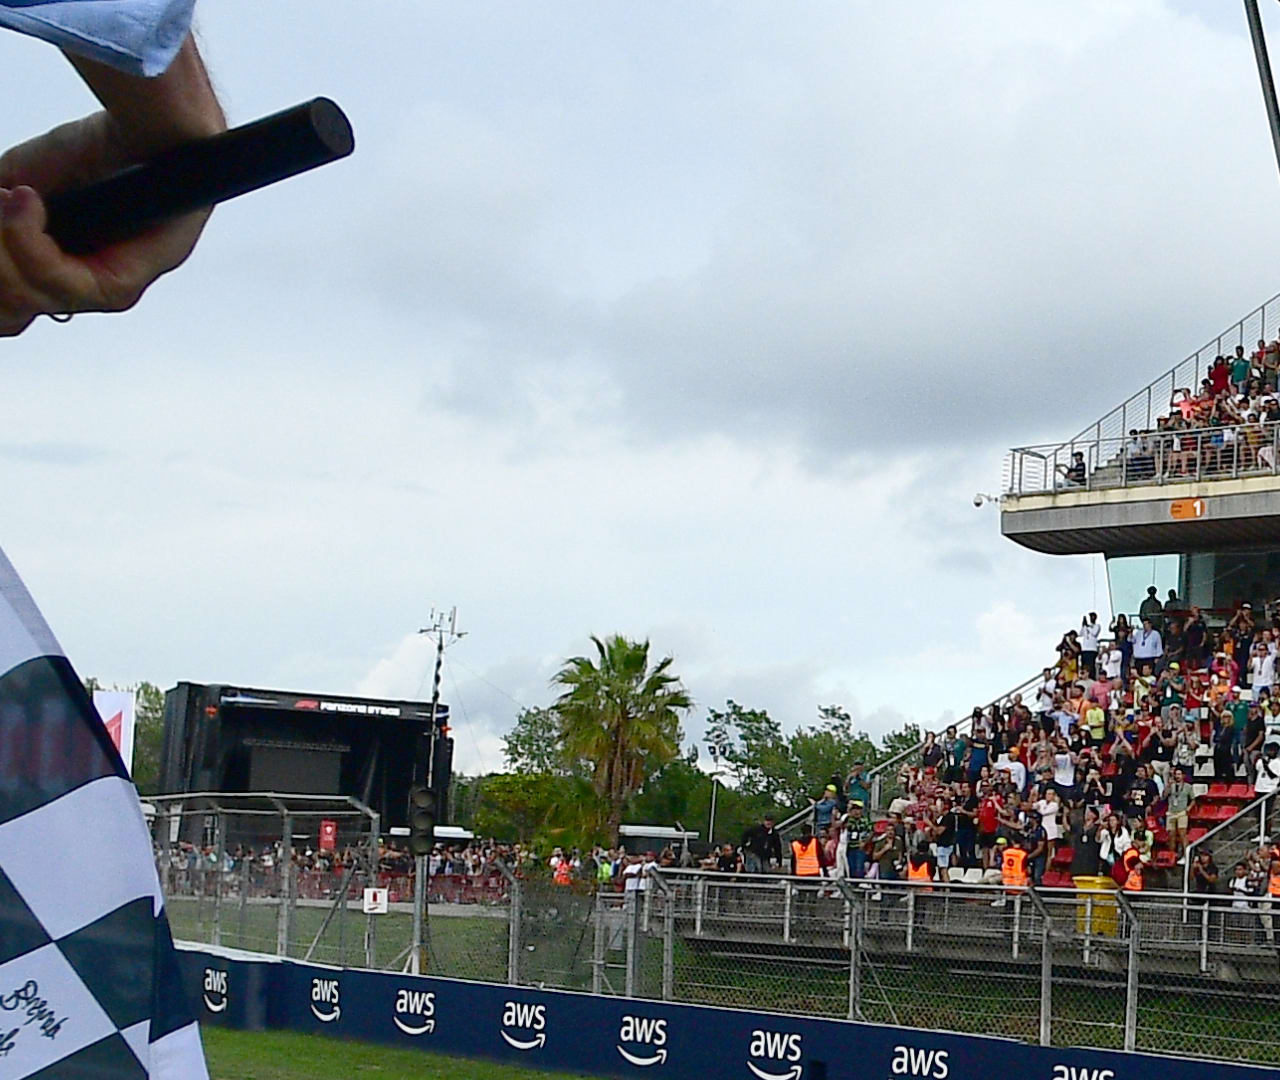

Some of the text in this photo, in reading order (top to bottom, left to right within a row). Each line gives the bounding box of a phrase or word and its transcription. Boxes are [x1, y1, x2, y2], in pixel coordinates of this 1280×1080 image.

[1193, 500, 1201, 517] 1
[205, 969, 227, 994] aws
[312, 979, 339, 1003] aws
[396, 990, 435, 1016] aws
[503, 1002, 546, 1030] aws
[620, 1016, 667, 1046] aws
[750, 1031, 802, 1062] aws
[891, 1047, 949, 1079] aws
